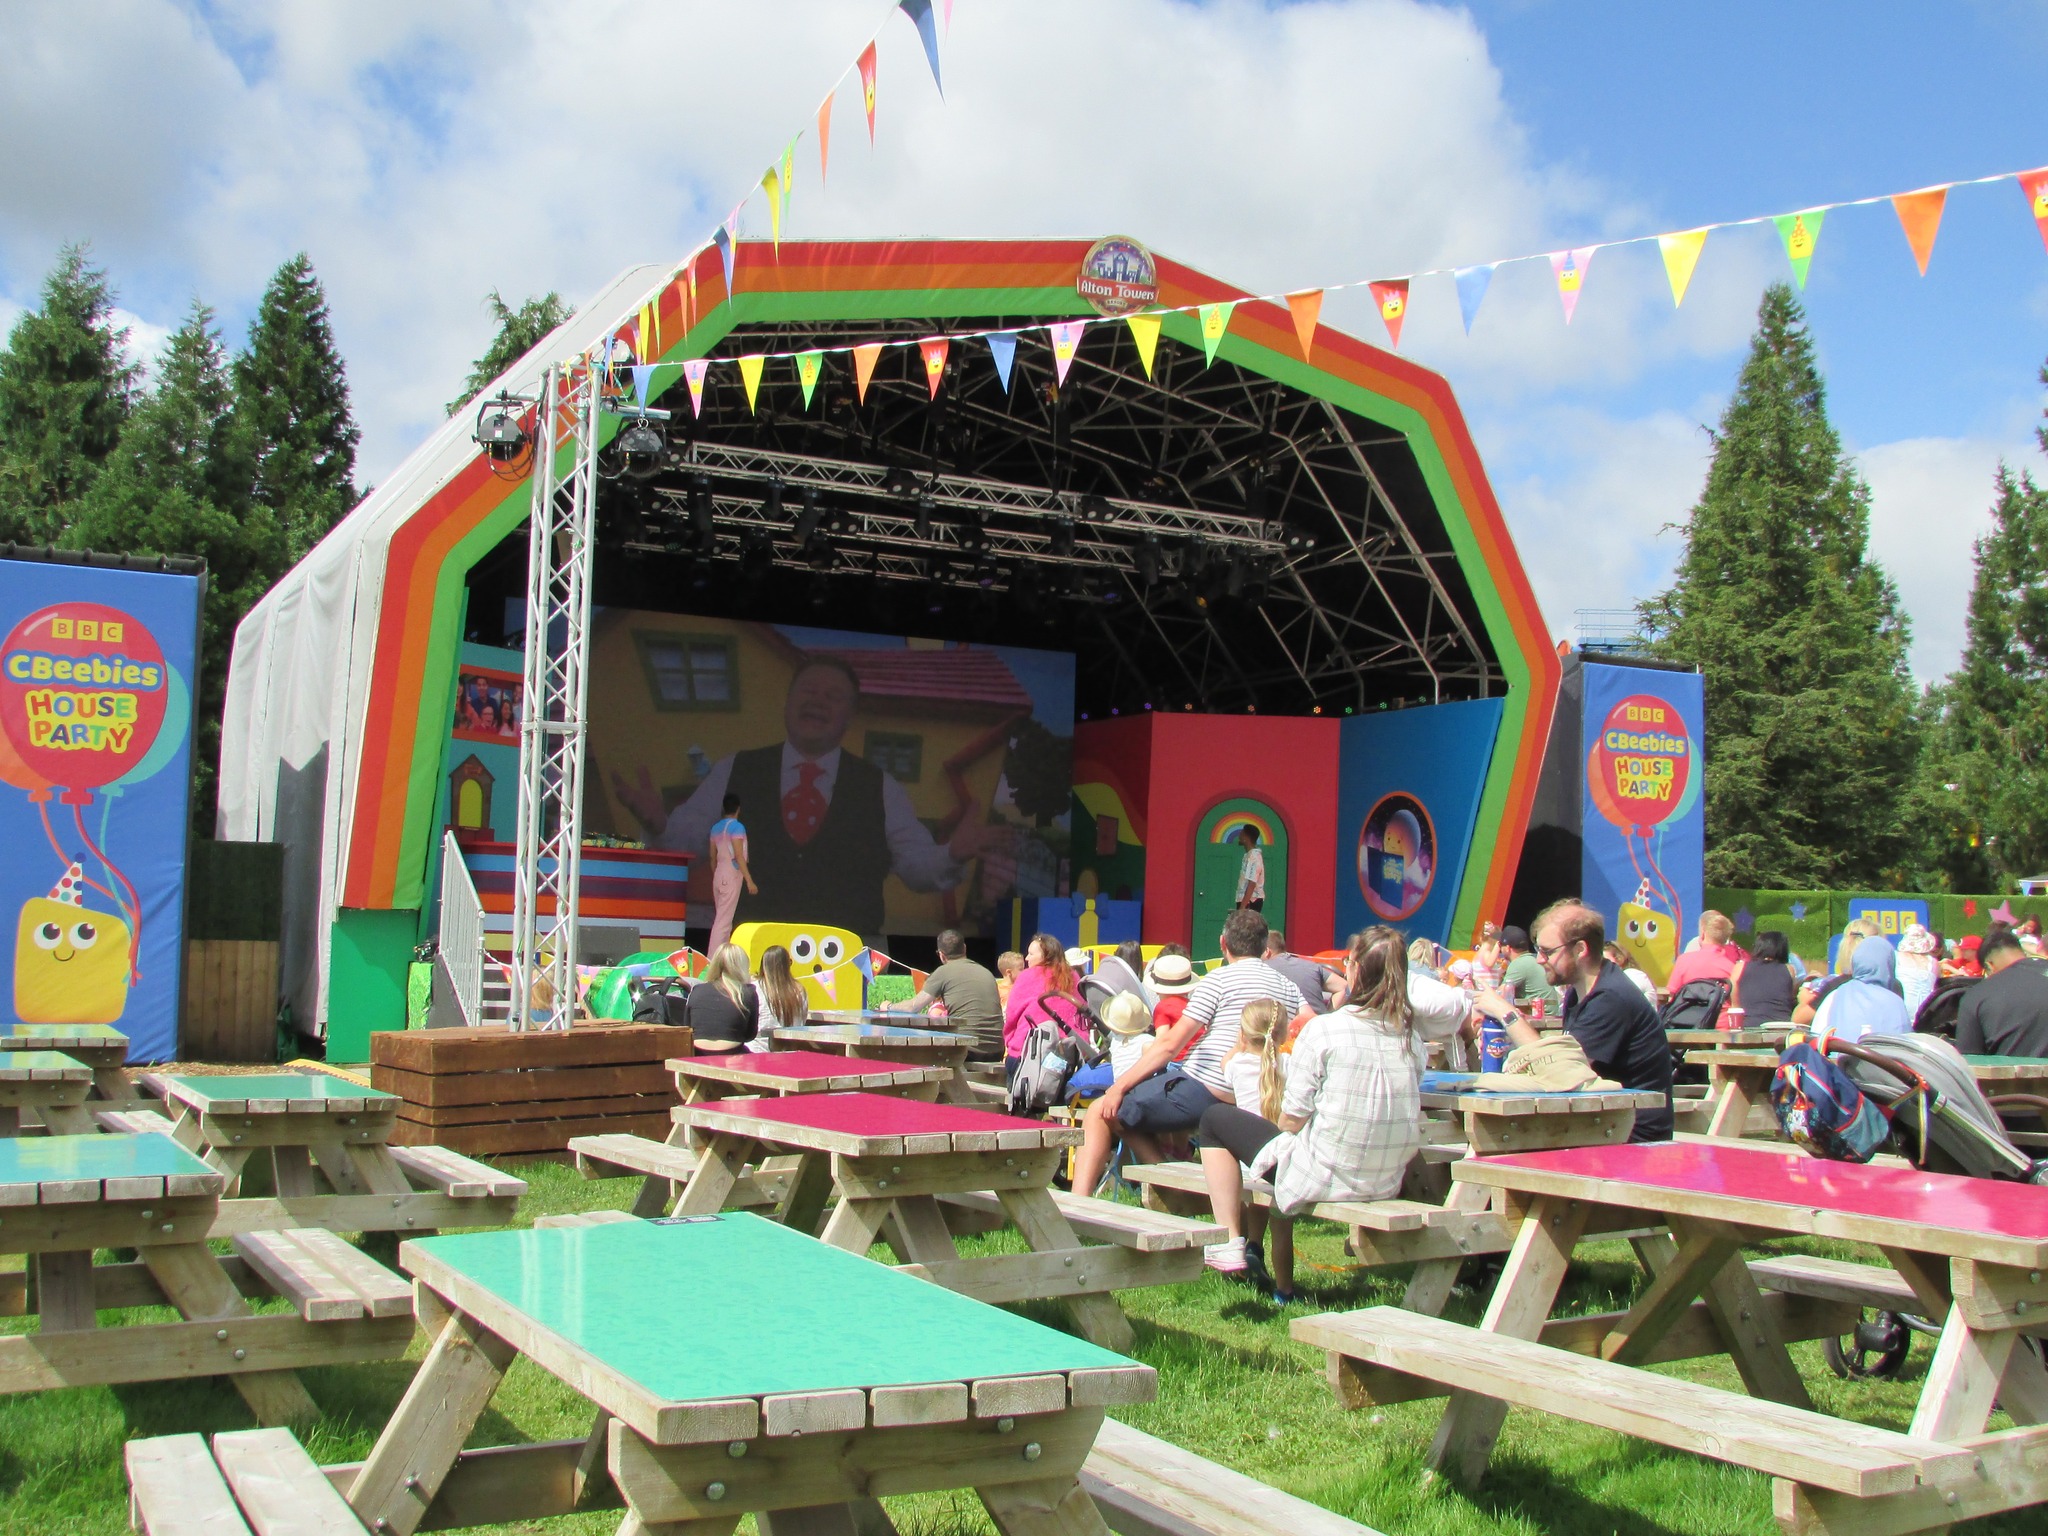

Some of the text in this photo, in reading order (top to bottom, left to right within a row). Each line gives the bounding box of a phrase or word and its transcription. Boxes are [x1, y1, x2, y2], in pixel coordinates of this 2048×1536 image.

[1081, 280, 1154, 300] Alton Towers
[55, 621, 120, 640] BBC
[8, 655, 159, 686] CBeebies
[30, 693, 132, 718] HOUSE
[1629, 708, 1662, 721] BBC
[34, 720, 128, 748] PARTY
[1606, 731, 1685, 753] CBeebies
[1617, 759, 1672, 776] HOUSE
[1619, 778, 1669, 797] PARTY
